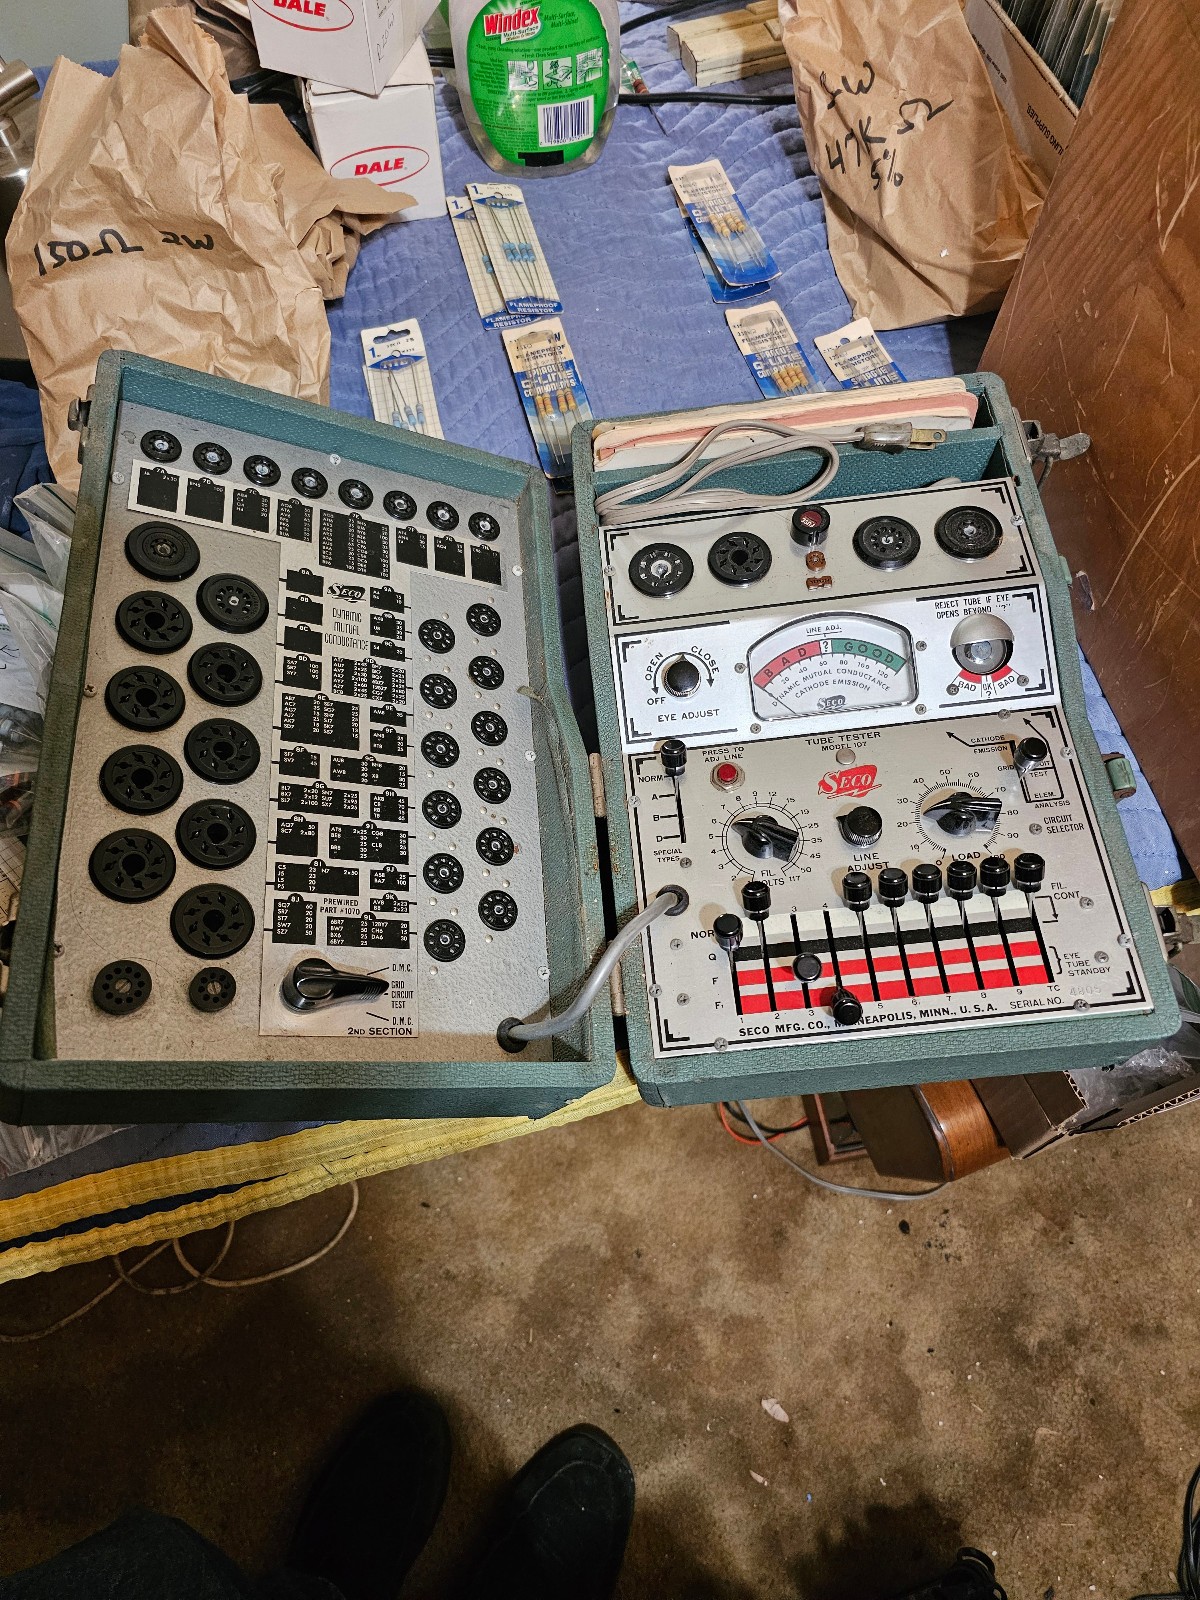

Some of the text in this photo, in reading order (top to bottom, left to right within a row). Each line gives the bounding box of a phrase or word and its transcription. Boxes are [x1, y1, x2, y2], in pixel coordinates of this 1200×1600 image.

[485, 7, 539, 35] Windex
[1026, 103, 1052, 138] SUPPLIES.
[354, 157, 404, 176] DALE
[493, 317, 532, 328] RESISTOR
[327, 582, 364, 599] SECO
[935, 594, 1010, 610] REJECT TUBE IF EYE
[332, 607, 362, 622] DYNAMIC
[936, 610, 960, 620] OPENS
[963, 606, 992, 616] BEYOND
[333, 622, 360, 636] MUTUAL
[805, 624, 842, 635] LINE ADJ.
[324, 633, 369, 650] CONDUCTANCE
[691, 645, 720, 674] CLOSE
[764, 641, 894, 678] BAD ? GOOD
[645, 652, 664, 681] OPEN
[781, 676, 790, 684] 20
[798, 666, 808, 674] 40
[857, 661, 870, 670] 100
[877, 669, 889, 679] 120
[772, 668, 891, 707] DYNAMIC MUTUAL CONDUCTANCE
[957, 681, 977, 692] BAD
[982, 682, 993, 691] OK
[997, 675, 1015, 690] BAD
[795, 679, 871, 699] CATHODE EMISSION
[985, 690, 992, 699] ?
[647, 695, 667, 706] OFF
[817, 695, 846, 710] SECO
[657, 708, 720, 723] EYE ADJUST
[805, 731, 881, 746] TUBE TESTER
[970, 735, 1005, 744] CATHODE
[702, 746, 745, 757] PRESS TO
[821, 741, 867, 752] MODEL 107
[974, 745, 1008, 754] EMISSION
[704, 753, 744, 763] ADJ LINE
[997, 764, 1015, 772] GRID
[638, 775, 664, 783] NORM
[818, 770, 872, 796] SECO
[652, 793, 658, 801] A
[1034, 791, 1057, 799] ELEM.
[1034, 800, 1071, 809] ANALYSIS
[653, 814, 660, 823] B
[1043, 814, 1073, 825] CIRCUIT
[1047, 823, 1085, 834] SELECTOR
[656, 835, 663, 843] D
[653, 848, 683, 856] SPECIAL
[853, 852, 880, 862] LINE
[952, 851, 981, 861] LOAD
[657, 855, 680, 863] TYPES
[848, 861, 890, 872] ADJUST
[763, 877, 785, 887] OLTS
[1051, 882, 1067, 890] FIL.
[1054, 890, 1083, 900] CONT.
[323, 897, 359, 907] PREWIRED
[690, 930, 715, 940] NOR
[708, 953, 717, 961] Q
[1064, 952, 1080, 960] EYE
[392, 963, 413, 972] D.M.C.
[1066, 959, 1090, 967] TUBE
[1068, 966, 1111, 977] STANDBY
[391, 980, 405, 989] GRID
[712, 976, 718, 985] F
[391, 990, 413, 999] CIRCUIT
[391, 1001, 406, 1009] TEST
[1010, 997, 1065, 1009] SERIAL NO.
[739, 1026, 770, 1037] SECO
[775, 1023, 805, 1034] MFG.
[807, 1020, 831, 1030] CO.,
[834, 1011, 916, 1028] MNEAPOLIS,
[919, 1006, 957, 1018] MINN.,
[347, 1027, 413, 1036] 2ND SECTION
